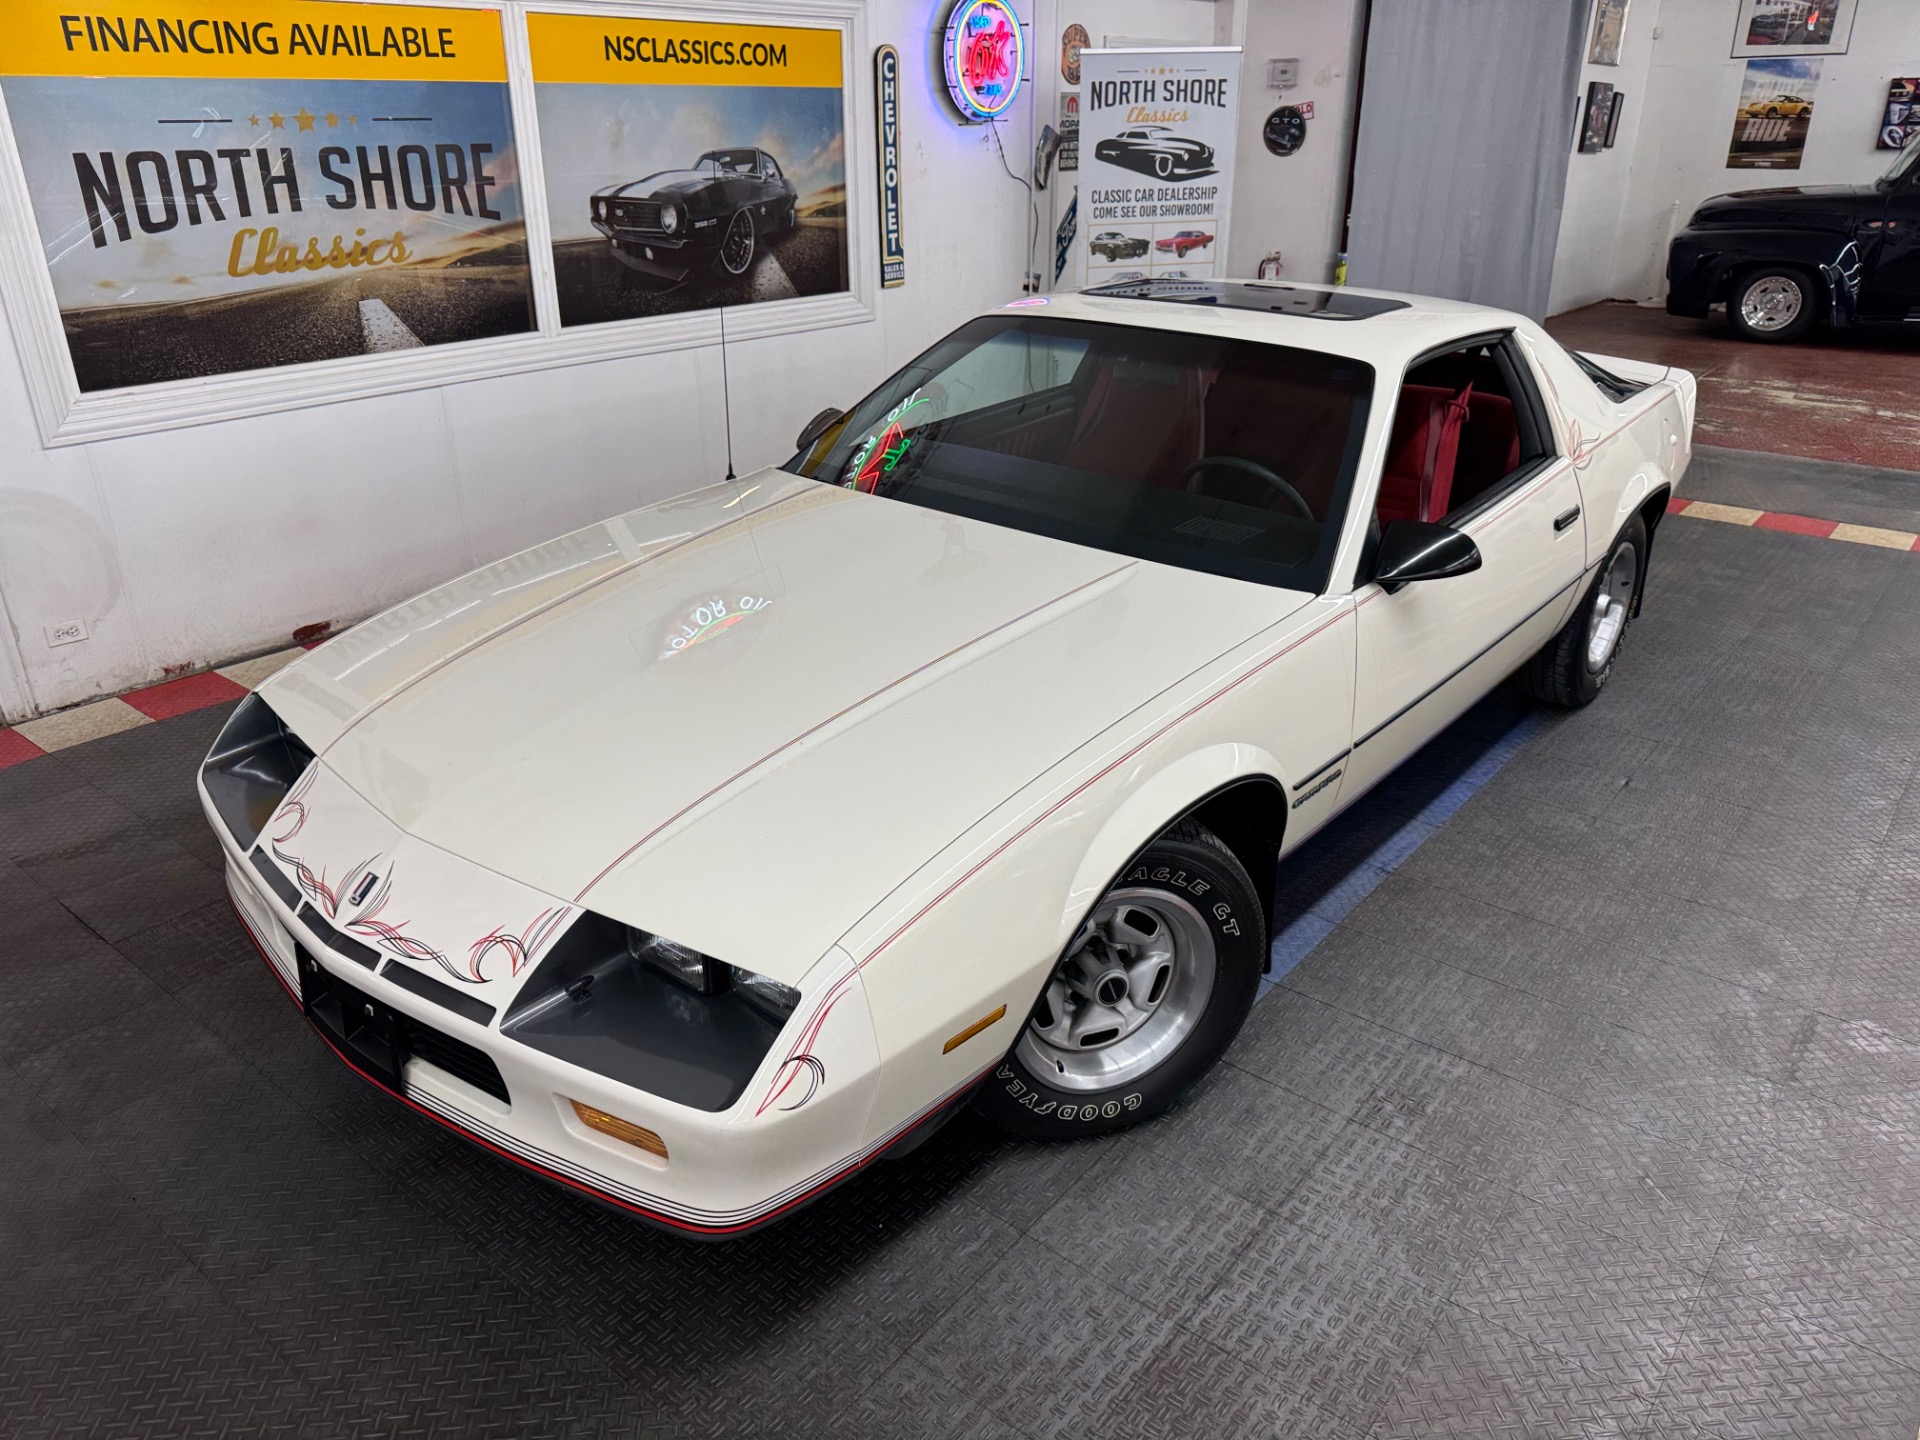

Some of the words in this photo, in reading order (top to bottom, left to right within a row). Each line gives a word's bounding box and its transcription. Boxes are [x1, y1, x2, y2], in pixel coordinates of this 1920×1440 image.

[60, 15, 279, 56] FINANCING
[289, 23, 456, 59] AVAILABLE
[604, 35, 787, 68] NSCLASSICS.COM
[1090, 79, 1156, 111] NORTH
[1163, 78, 1228, 108] SHORE
[1125, 106, 1190, 124] Classics
[1271, 117, 1301, 125] GTO
[1741, 118, 1792, 142] RIDE
[882, 57, 899, 252] CHEVROLET
[72, 147, 304, 249] NORTH
[317, 142, 501, 221] SHORE
[1091, 188, 1132, 205] CLASSIC
[1134, 188, 1154, 203] CAR
[1157, 186, 1218, 202] DEALERSHIP
[1093, 206, 1119, 219] COME
[1120, 205, 1137, 218] SEE
[1139, 204, 1158, 217] OUR
[1159, 203, 1214, 216] SHOWROOM!
[226, 227, 413, 278] Classics
[1117, 867, 1211, 896] AGLE
[1213, 903, 1240, 936] GT
[996, 1063, 1142, 1121] GOODYEA
